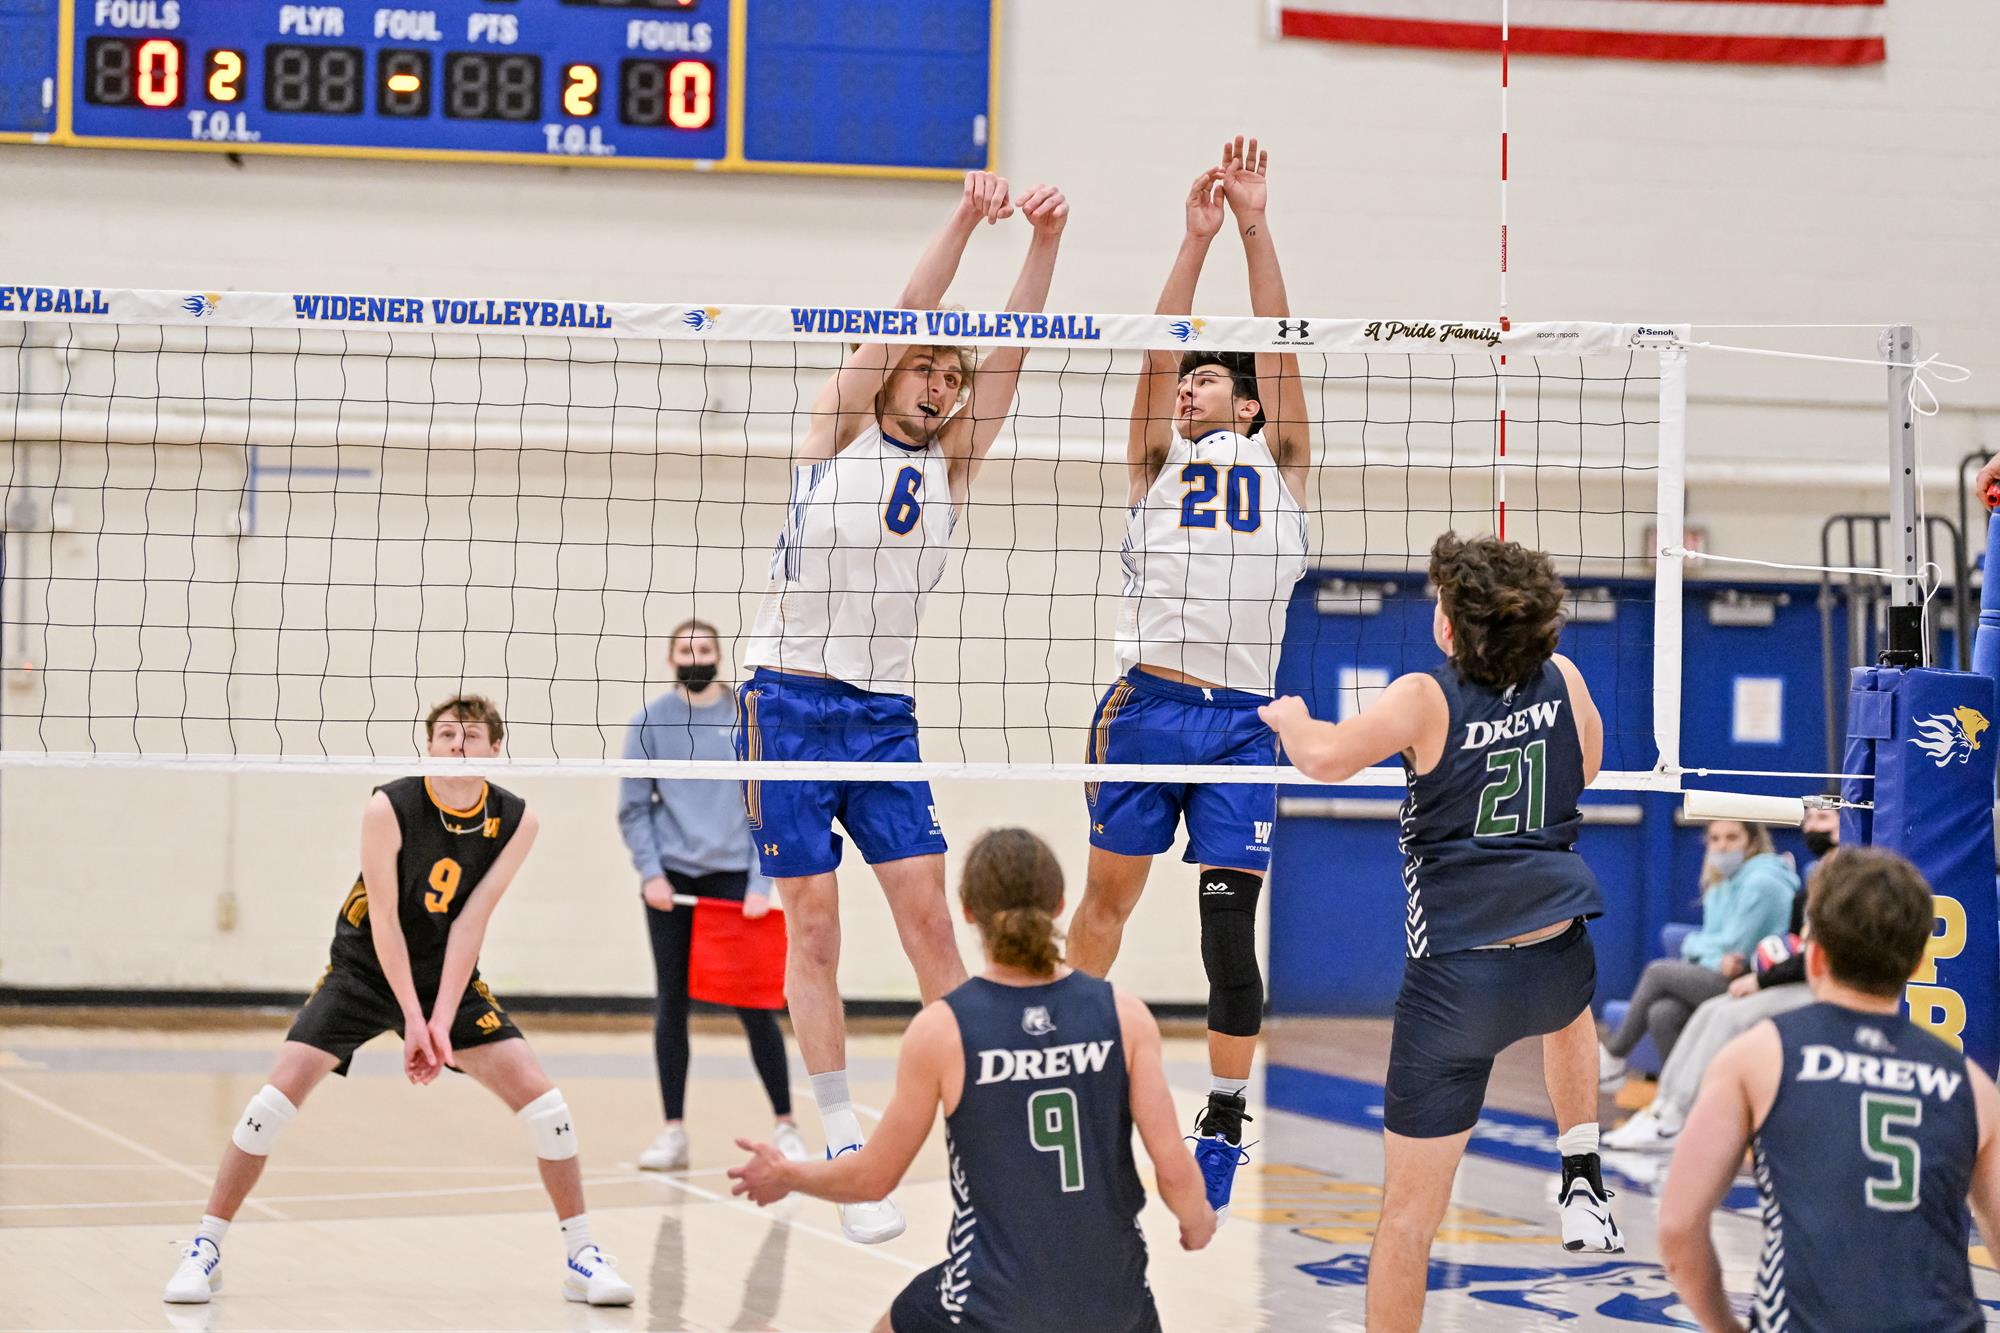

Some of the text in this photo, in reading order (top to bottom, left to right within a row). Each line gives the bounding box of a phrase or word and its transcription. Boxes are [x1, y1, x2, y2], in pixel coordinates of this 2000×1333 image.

[95, 1, 180, 30] FOULS
[279, 5, 344, 37] PLYR
[374, 9, 443, 41] FOUL
[467, 13, 519, 45] PTS
[627, 20, 713, 53] FOULS
[138, 39, 180, 107] 0
[208, 50, 242, 101] 2
[564, 65, 598, 116] 2
[668, 60, 713, 129] 0
[188, 110, 260, 142] T.O.L.
[544, 124, 615, 156] T.O.L.
[0, 286, 109, 314] EYBALL
[293, 294, 612, 329] WIDENER VOLLEYBALL
[791, 308, 1101, 340] WIDENER VOLLEYBALL
[1364, 321, 1502, 348] A Pride Family
[1646, 328, 1674, 336] Senoh
[883, 464, 923, 537] 6
[1178, 461, 1263, 536] 20
[1460, 700, 1562, 750] DREW
[1473, 739, 1546, 837] 21
[1254, 821, 1273, 844] W
[424, 857, 462, 913] 9
[976, 1040, 1115, 1085] DREW
[1796, 1044, 1962, 1101] DREW
[1027, 1087, 1085, 1193] 9
[1860, 1090, 1923, 1212] 5
